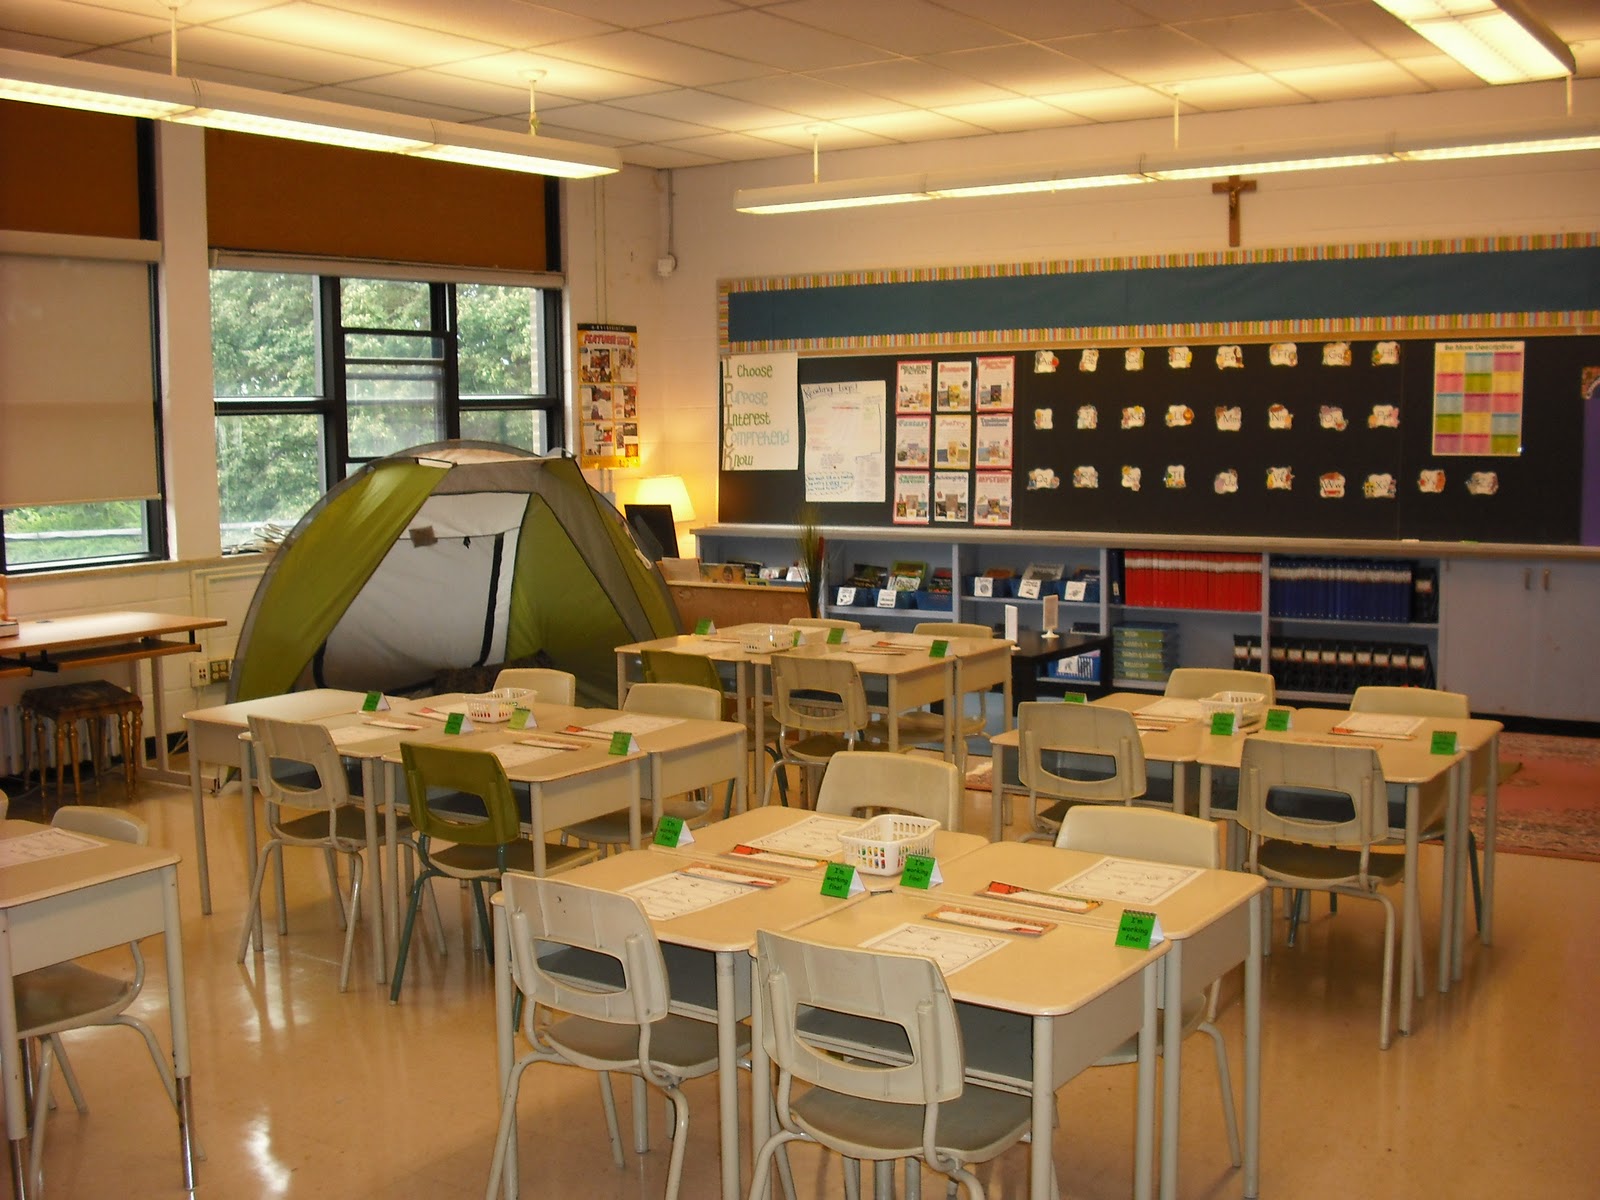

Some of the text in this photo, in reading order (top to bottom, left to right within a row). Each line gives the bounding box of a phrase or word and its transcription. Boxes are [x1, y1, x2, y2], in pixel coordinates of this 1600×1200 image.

[737, 364, 773, 378] Choose
[725, 383, 769, 407] Purpose
[724, 405, 771, 427] Interest
[906, 868, 929, 877] working
[826, 876, 849, 885] working
[1122, 926, 1149, 936] working
[1125, 934, 1142, 943] fine!
